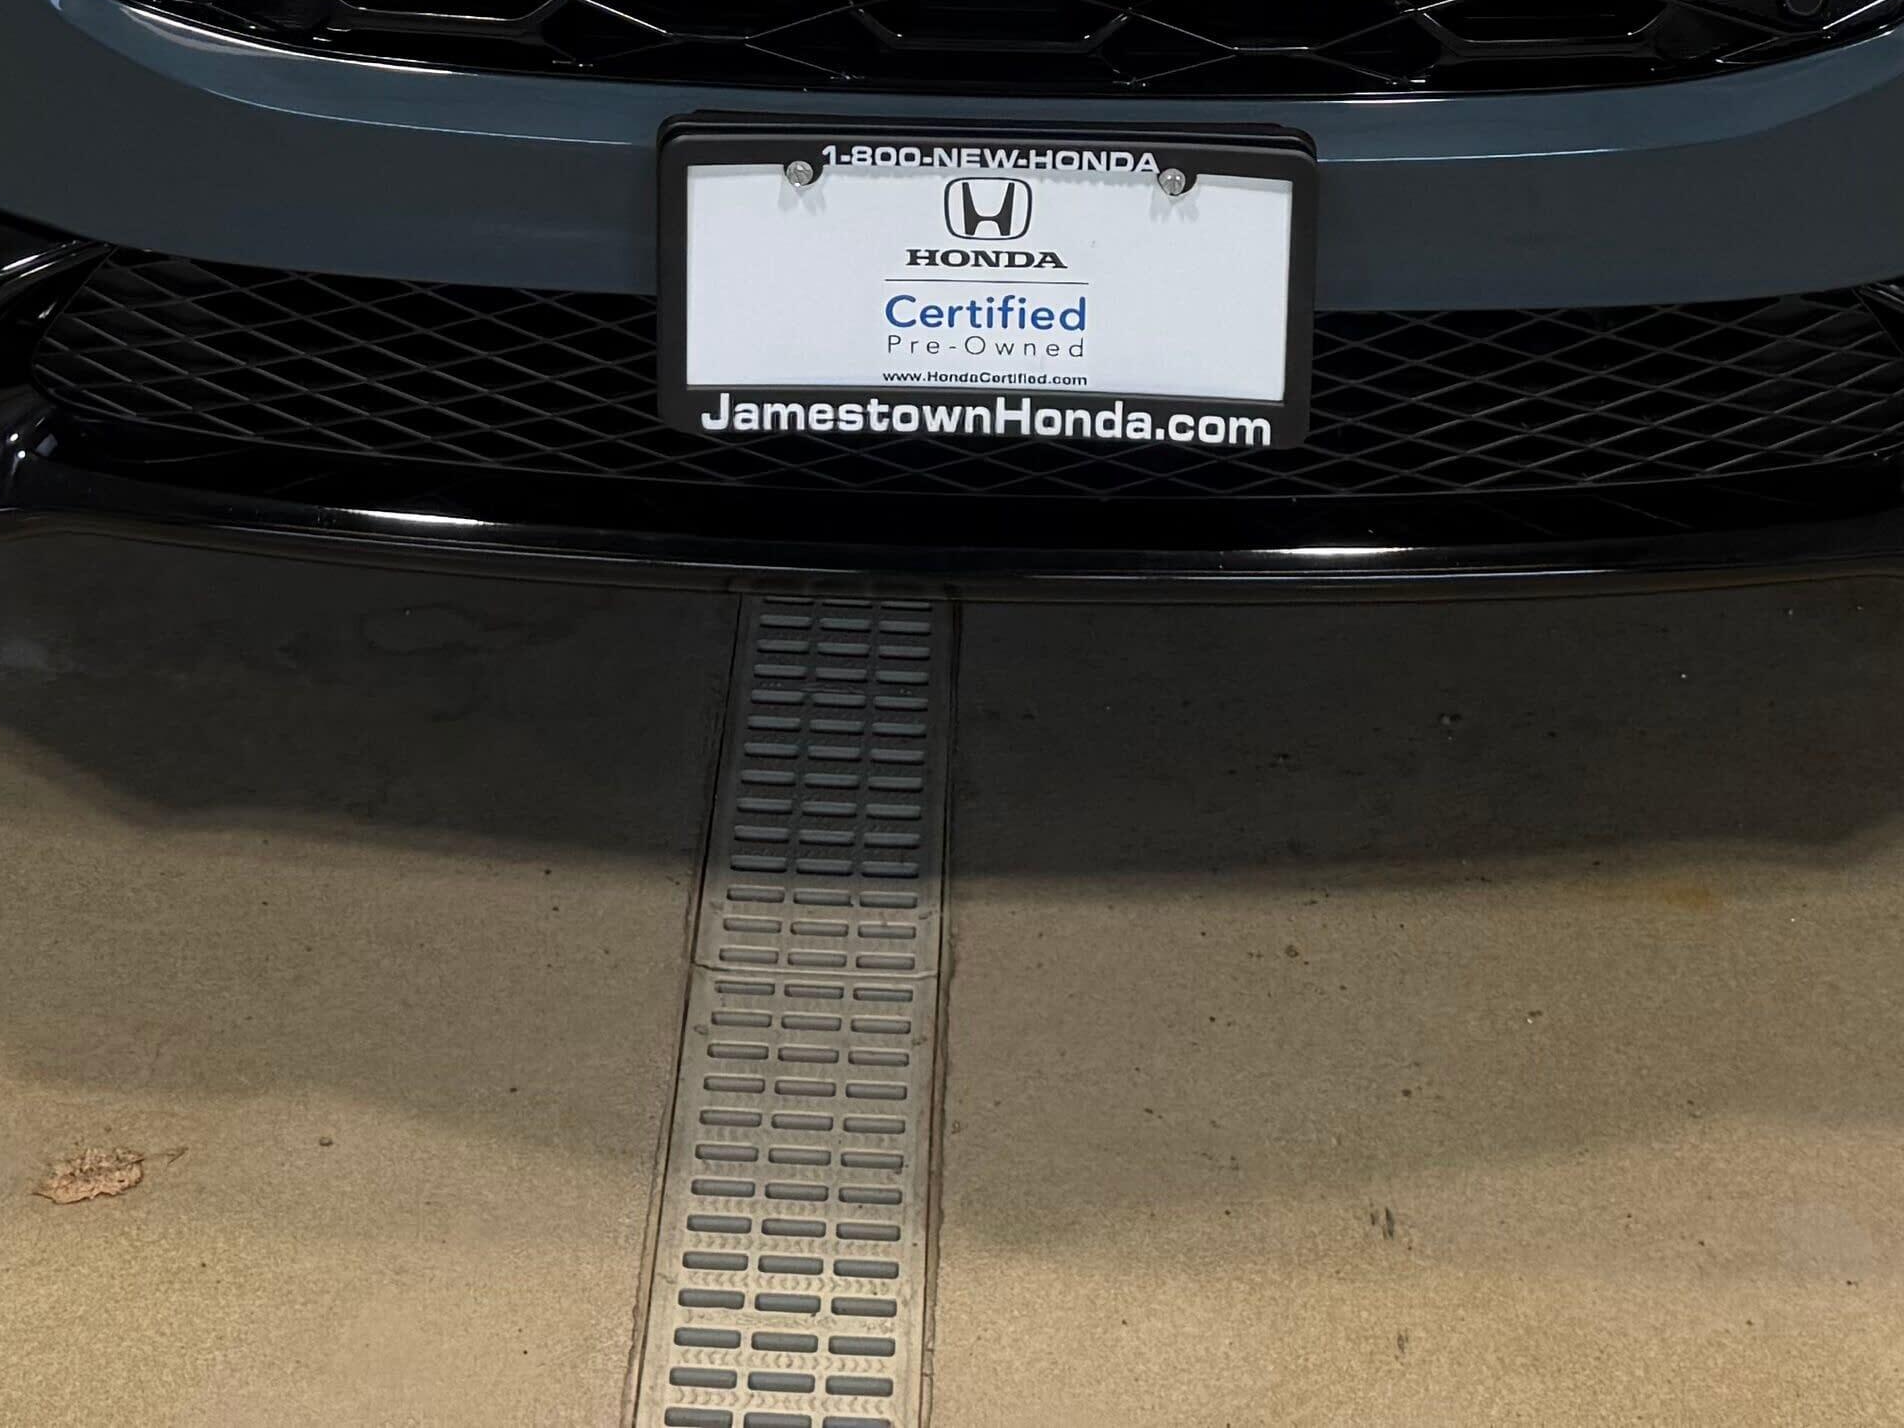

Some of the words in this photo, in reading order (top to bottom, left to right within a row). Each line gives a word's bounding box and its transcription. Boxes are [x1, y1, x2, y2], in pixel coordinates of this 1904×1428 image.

[822, 145, 1160, 174] 1-800-NEW-HONDA
[905, 248, 1068, 269] HONDA
[885, 294, 1086, 331] Certified
[887, 334, 1084, 358] Pre-Owned
[882, 371, 1088, 386] www.HondaCertified.com
[700, 392, 1272, 447] JamestownHonda.com
